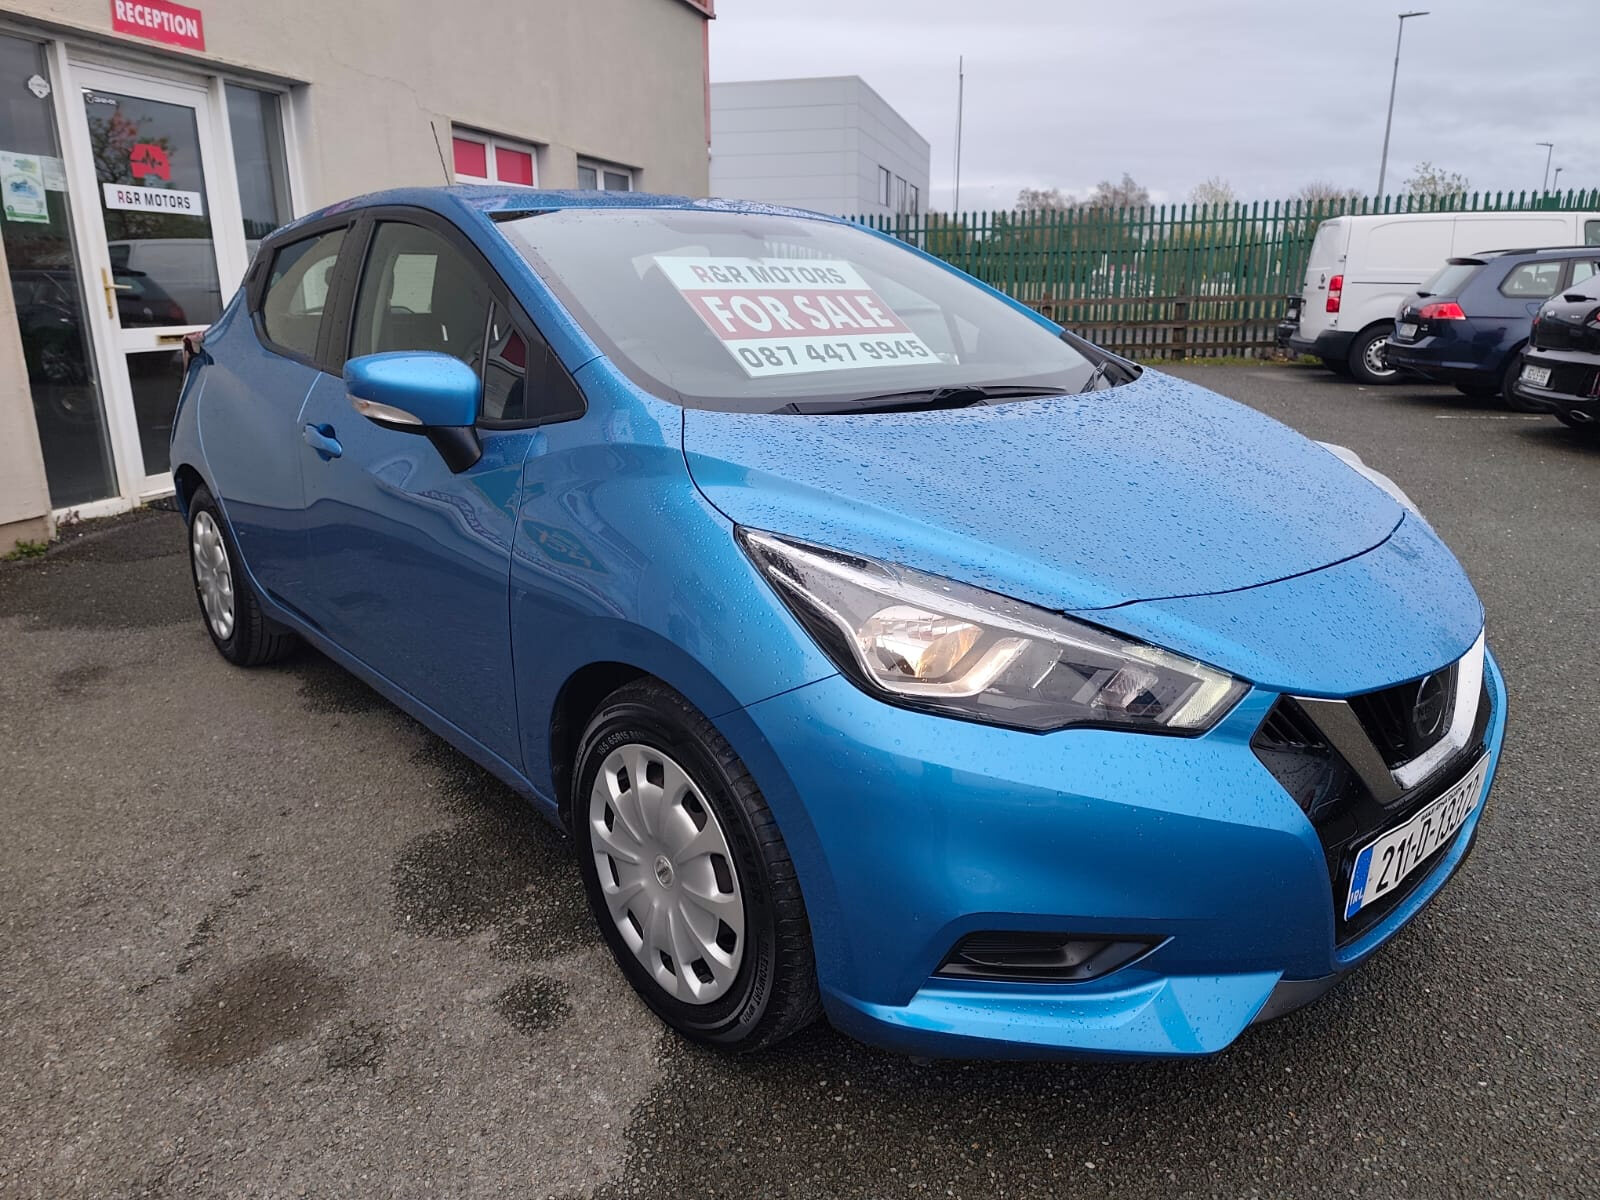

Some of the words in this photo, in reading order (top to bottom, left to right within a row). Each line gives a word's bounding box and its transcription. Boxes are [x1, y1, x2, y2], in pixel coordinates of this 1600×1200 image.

[115, 0, 198, 38] RECEPTION
[117, 190, 141, 206] R&R
[144, 193, 191, 209] MOTORS
[689, 265, 748, 284] R&R
[746, 265, 847, 285] MOTORS
[701, 296, 803, 333] FOR
[793, 295, 896, 330] SALE
[738, 345, 797, 368] 087
[805, 342, 858, 363] 447
[861, 340, 930, 360] 9945
